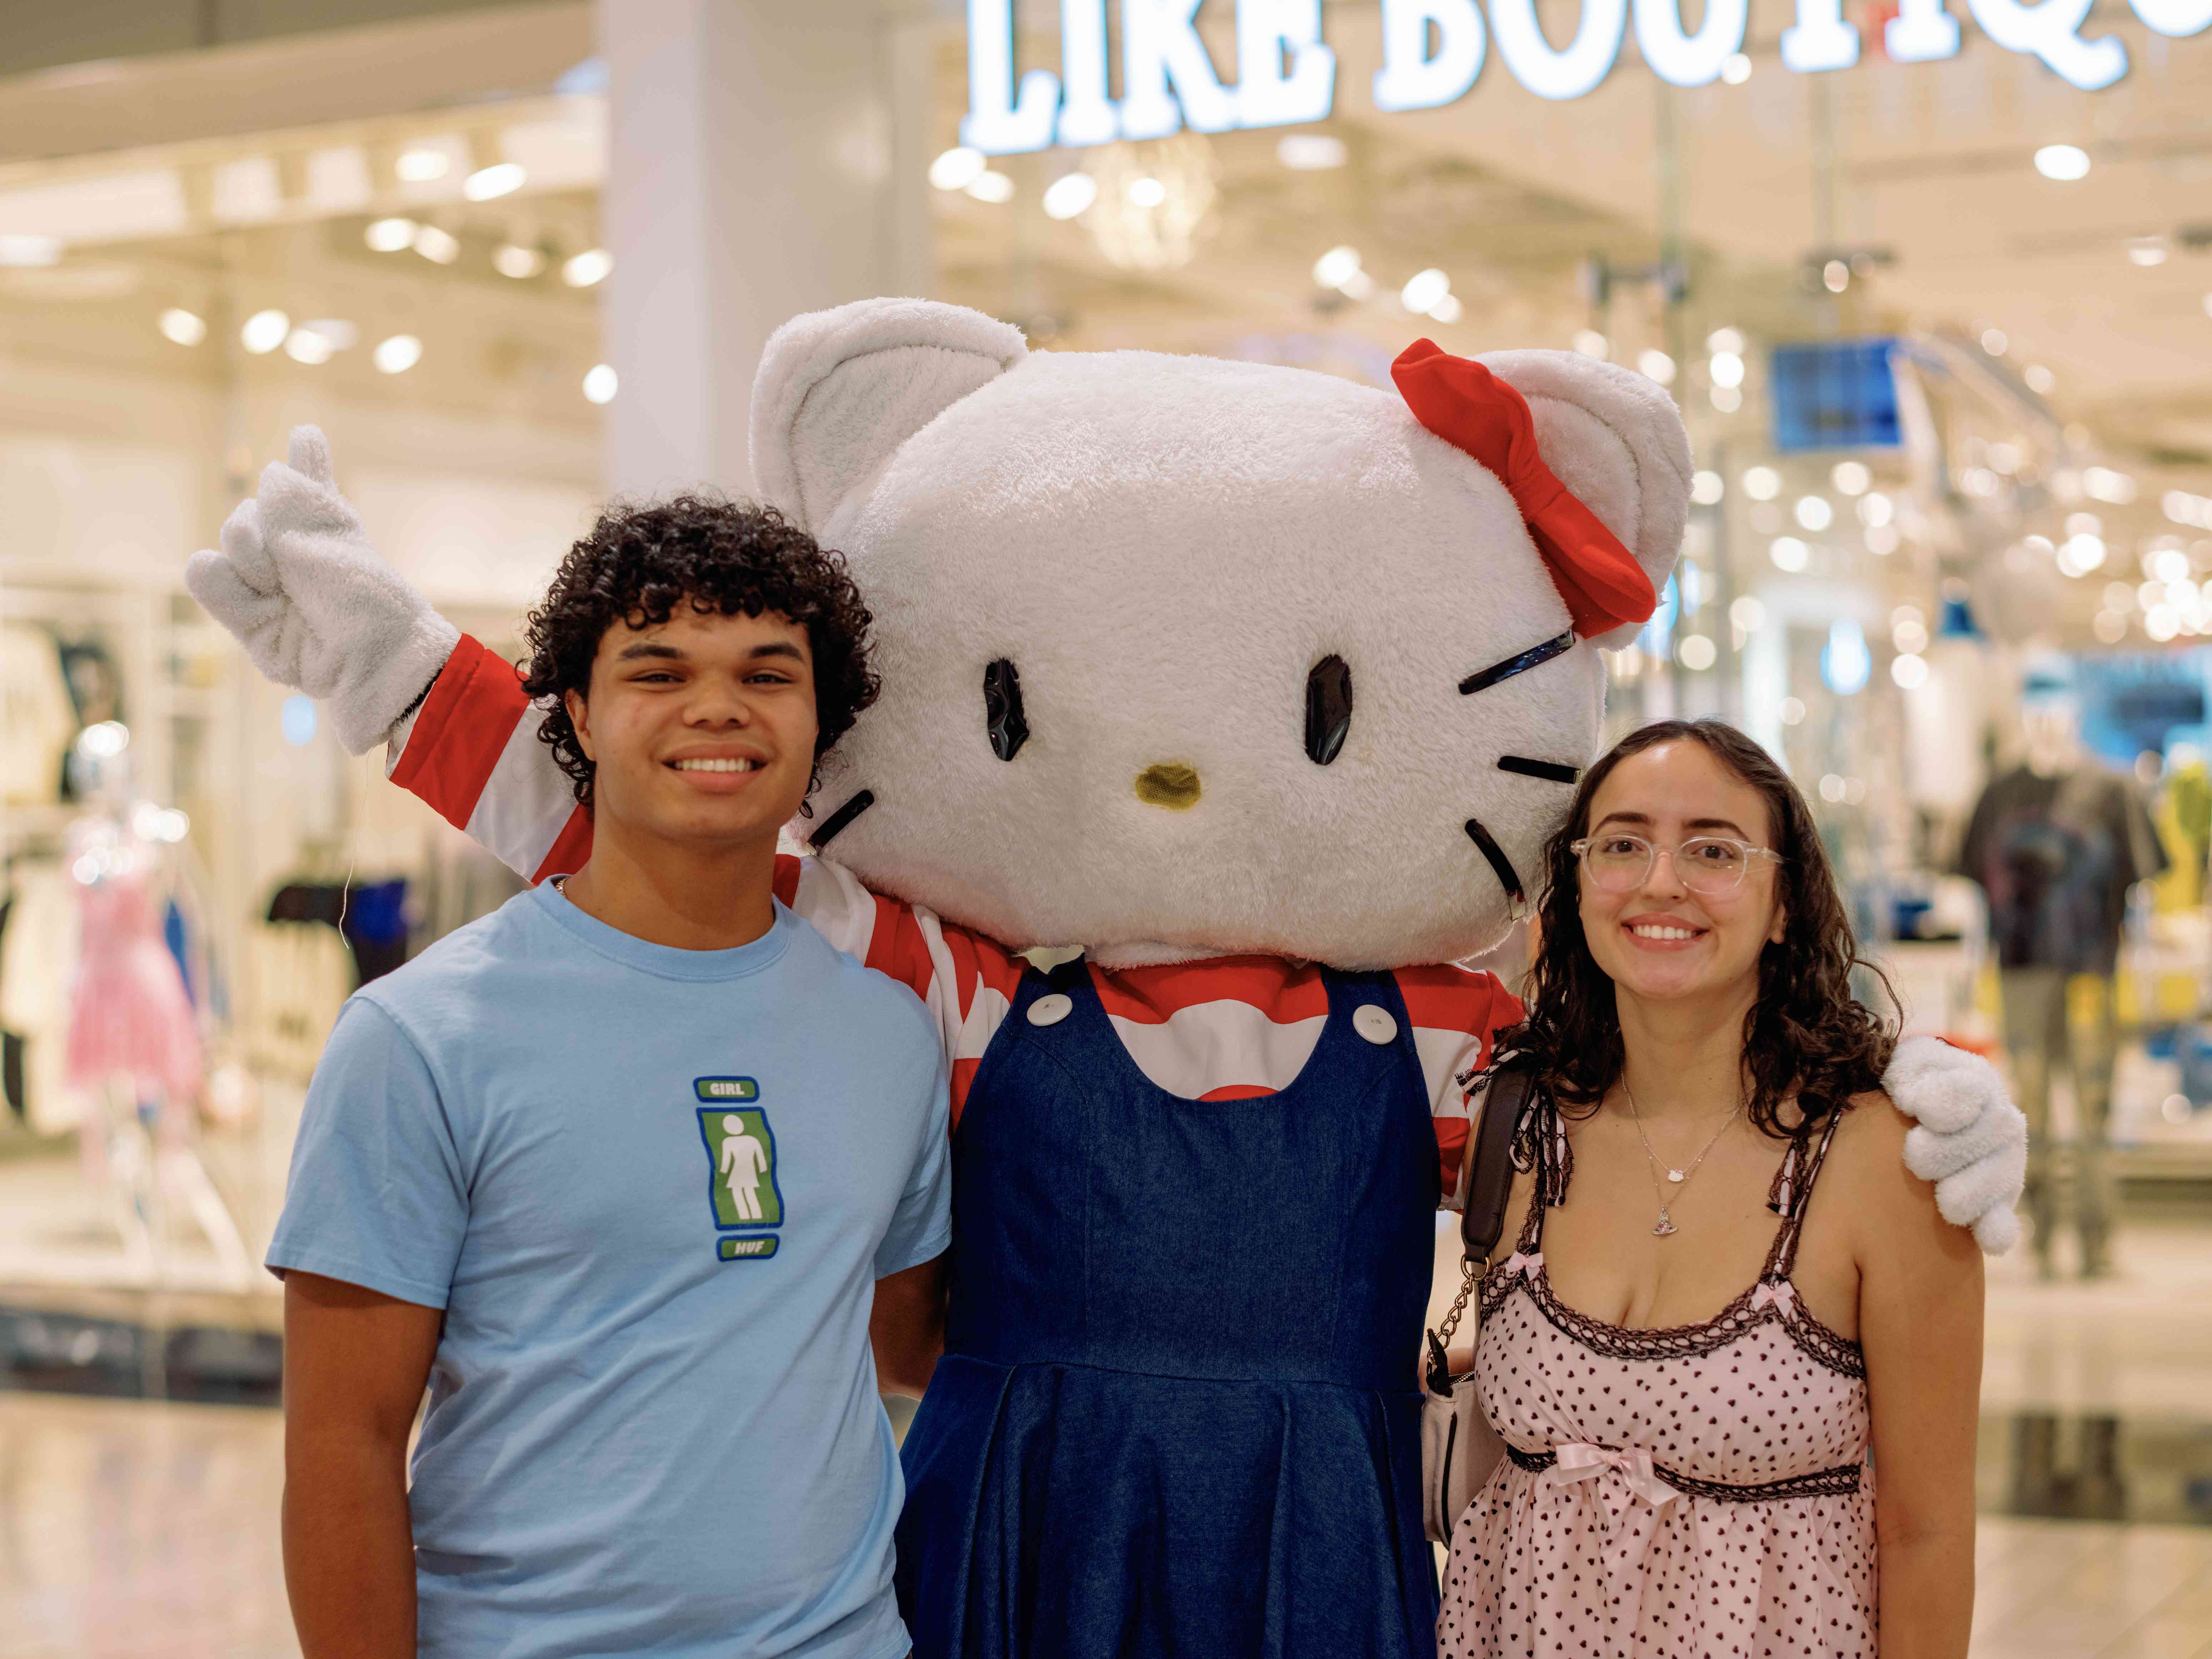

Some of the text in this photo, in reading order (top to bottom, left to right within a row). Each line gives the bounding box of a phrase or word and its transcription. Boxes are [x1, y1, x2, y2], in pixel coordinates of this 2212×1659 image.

[959, 0, 1335, 156] LIKE
[709, 1082, 744, 1095] GIRL
[734, 1240, 764, 1255] HUF
